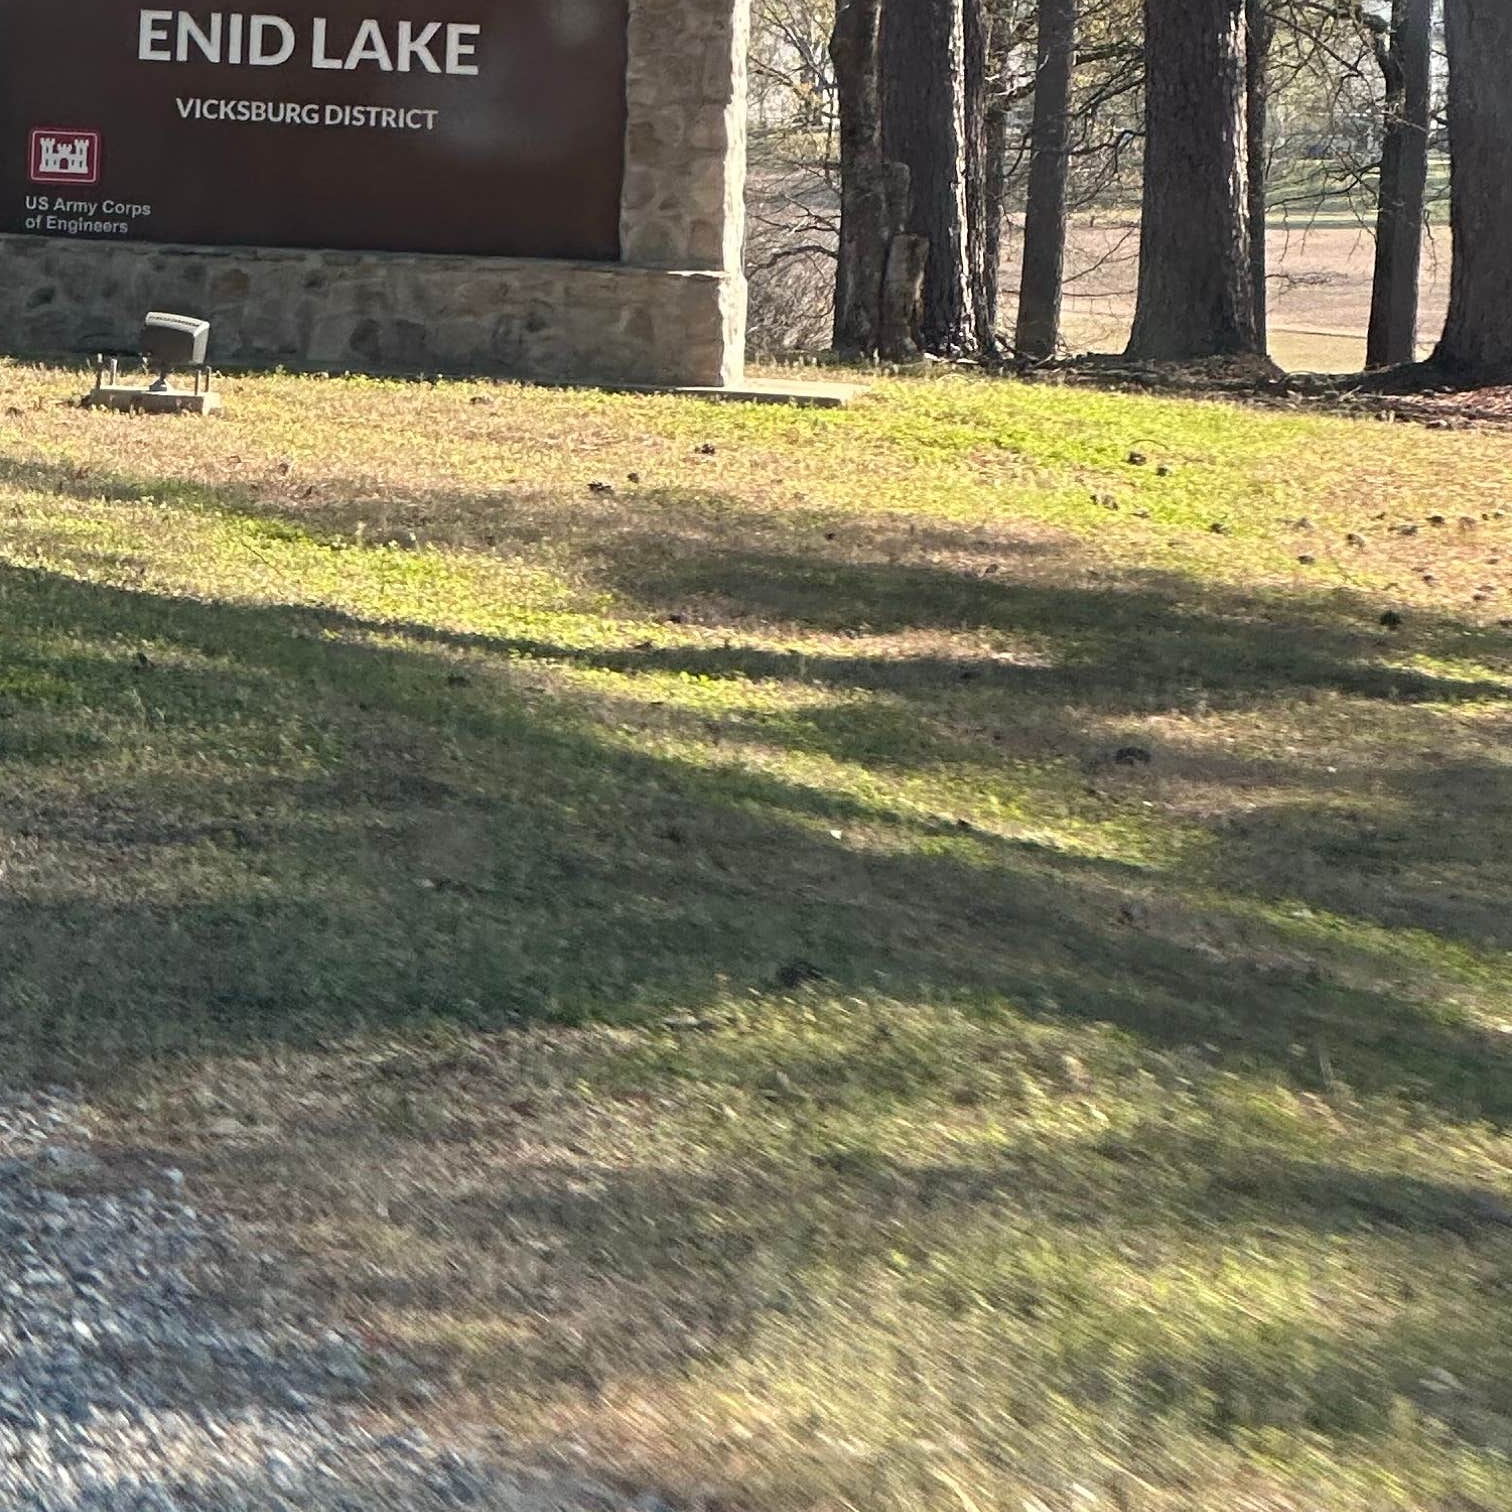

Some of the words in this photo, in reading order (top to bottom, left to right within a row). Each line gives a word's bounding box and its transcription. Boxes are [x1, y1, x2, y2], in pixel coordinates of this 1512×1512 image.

[139, 10, 294, 65] ENID
[312, 18, 480, 75] LAKE
[176, 98, 319, 123] VICKSBURG
[325, 105, 438, 129] DISTRICT
[25, 196, 49, 210] US
[53, 198, 97, 216] Army
[103, 200, 150, 218] Corps
[25, 214, 42, 229] of
[47, 217, 128, 233] Engineers
